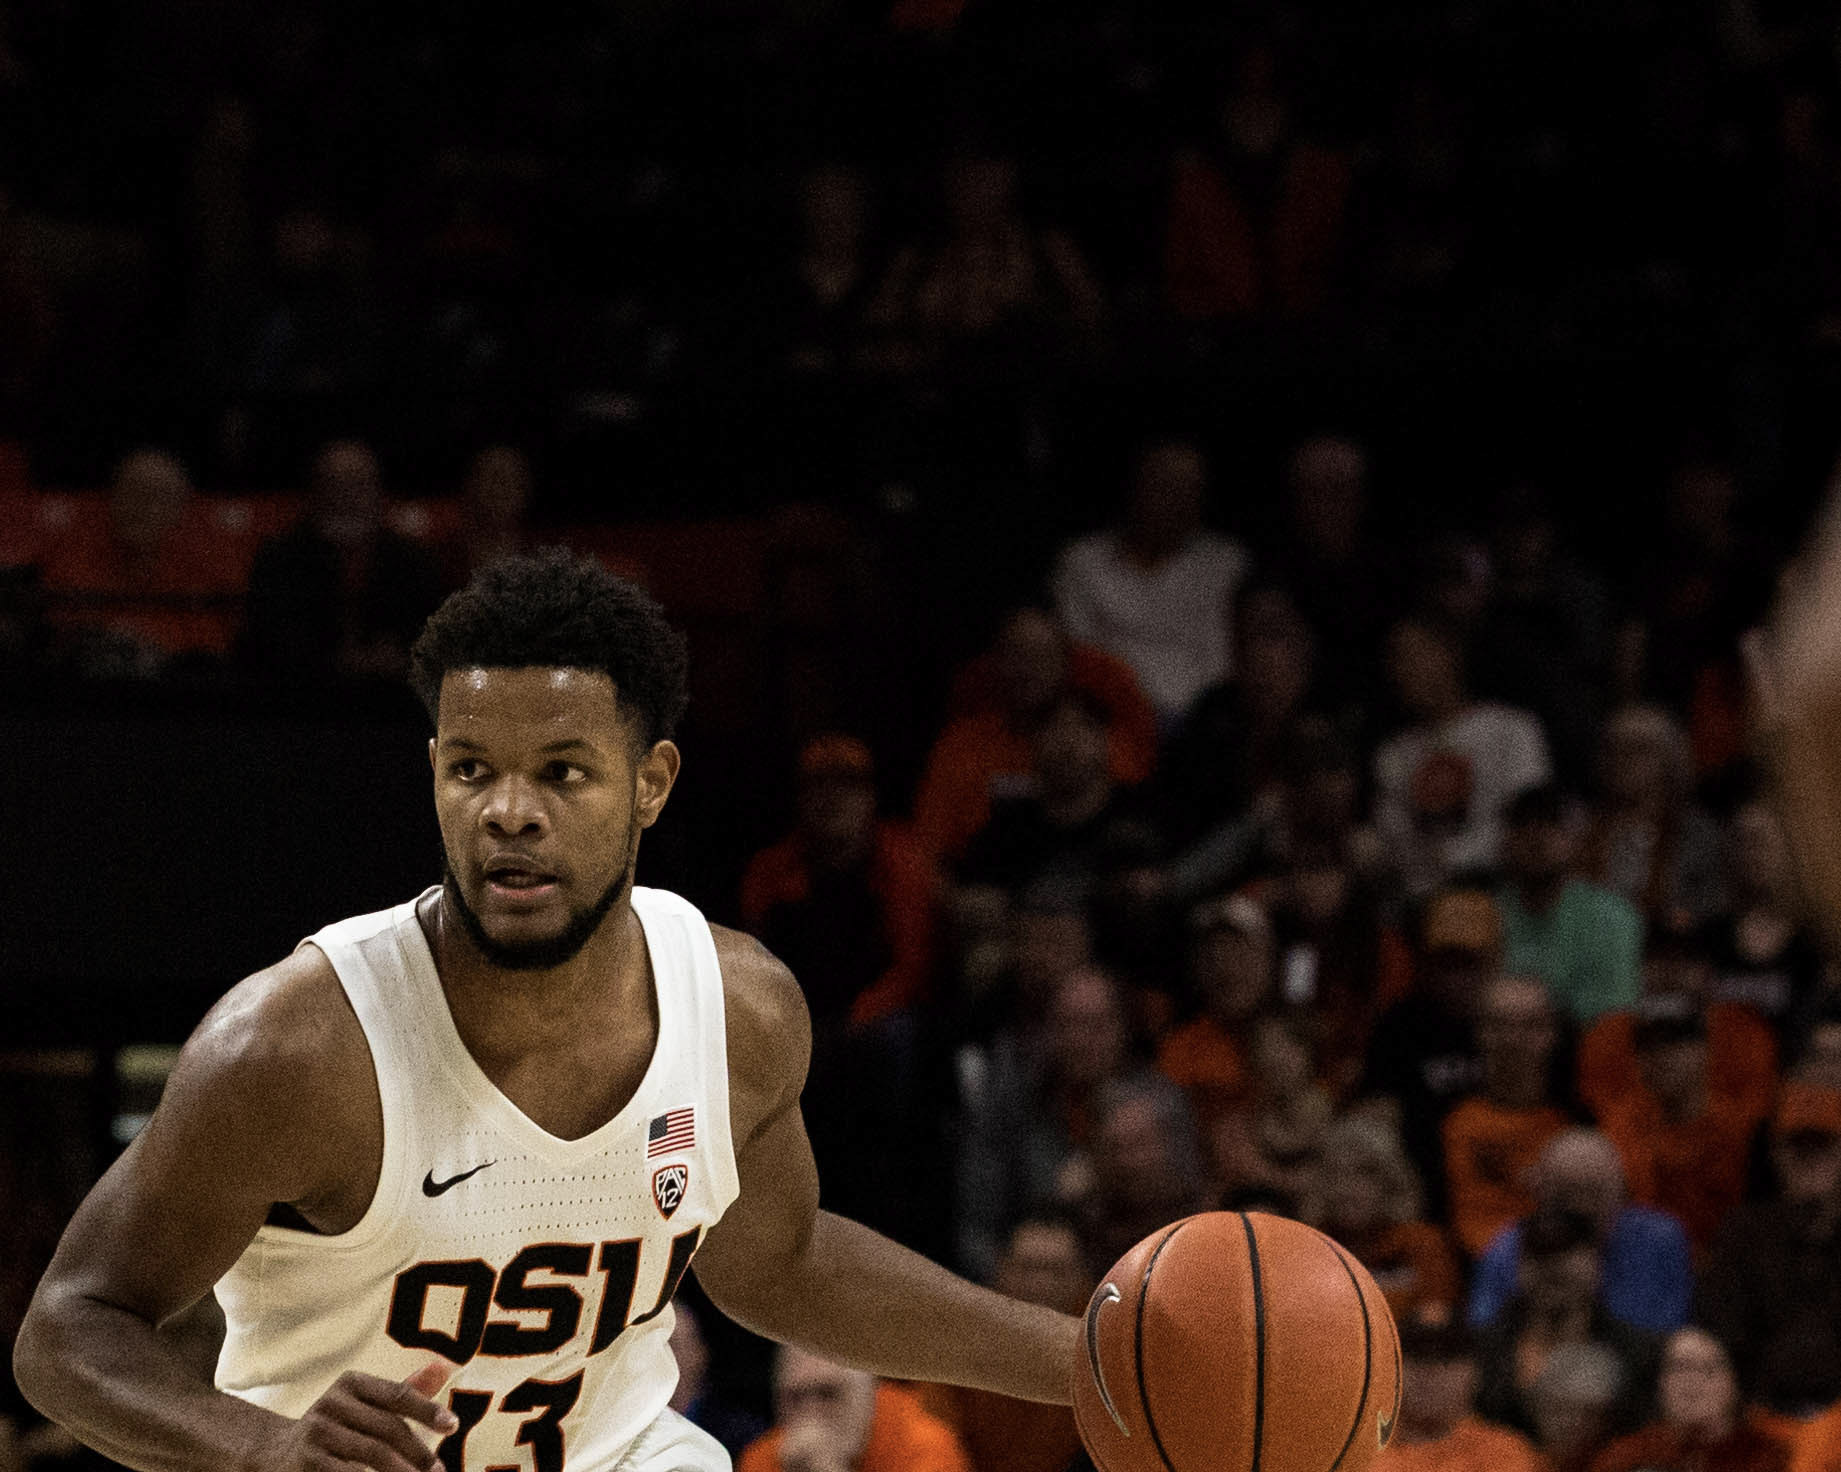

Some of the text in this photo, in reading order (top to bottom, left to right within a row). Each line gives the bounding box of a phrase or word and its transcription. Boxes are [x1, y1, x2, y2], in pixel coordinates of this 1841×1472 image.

[656, 1167, 686, 1200] PAC
[661, 1187, 679, 1209] 12
[385, 1223, 704, 1367] OSU
